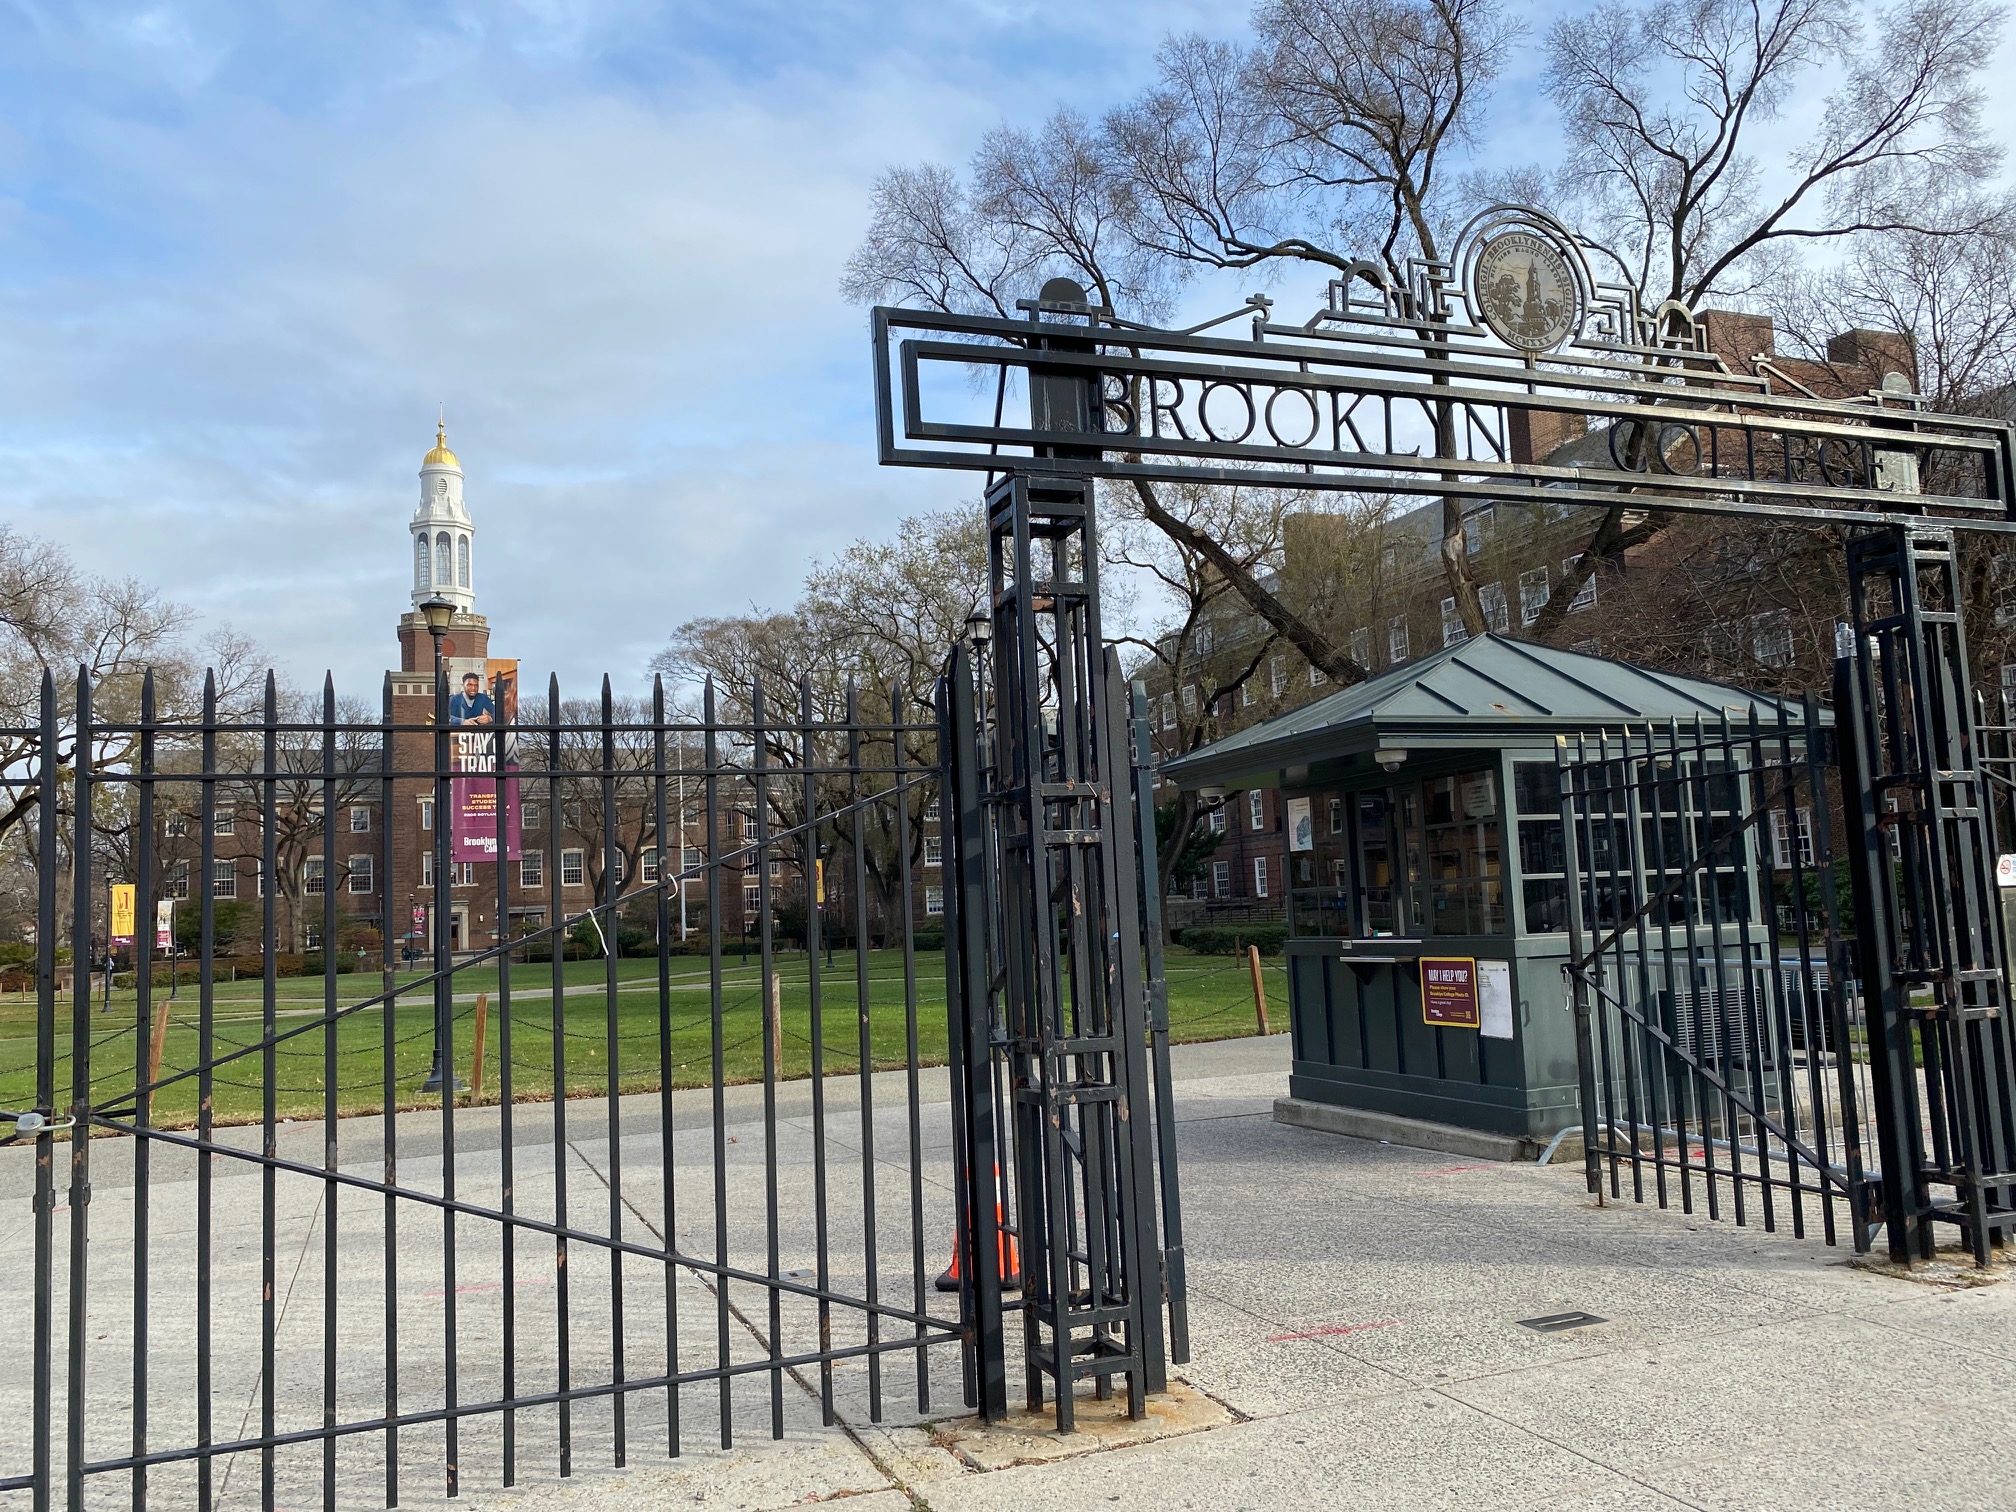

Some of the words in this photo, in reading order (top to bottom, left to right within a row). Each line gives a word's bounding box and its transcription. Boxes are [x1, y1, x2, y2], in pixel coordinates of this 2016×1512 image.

[1506, 329, 1553, 347] MCMXXX
[1098, 370, 1506, 463] BROOKLYN
[458, 731, 495, 755] STAY
[458, 755, 497, 773] TRAC
[463, 836, 497, 847] Brooklyn
[484, 844, 510, 853] Colle
[1428, 969, 1438, 982] MAY
[1442, 969, 1454, 982] HELP
[1454, 969, 1468, 983] YOU?
